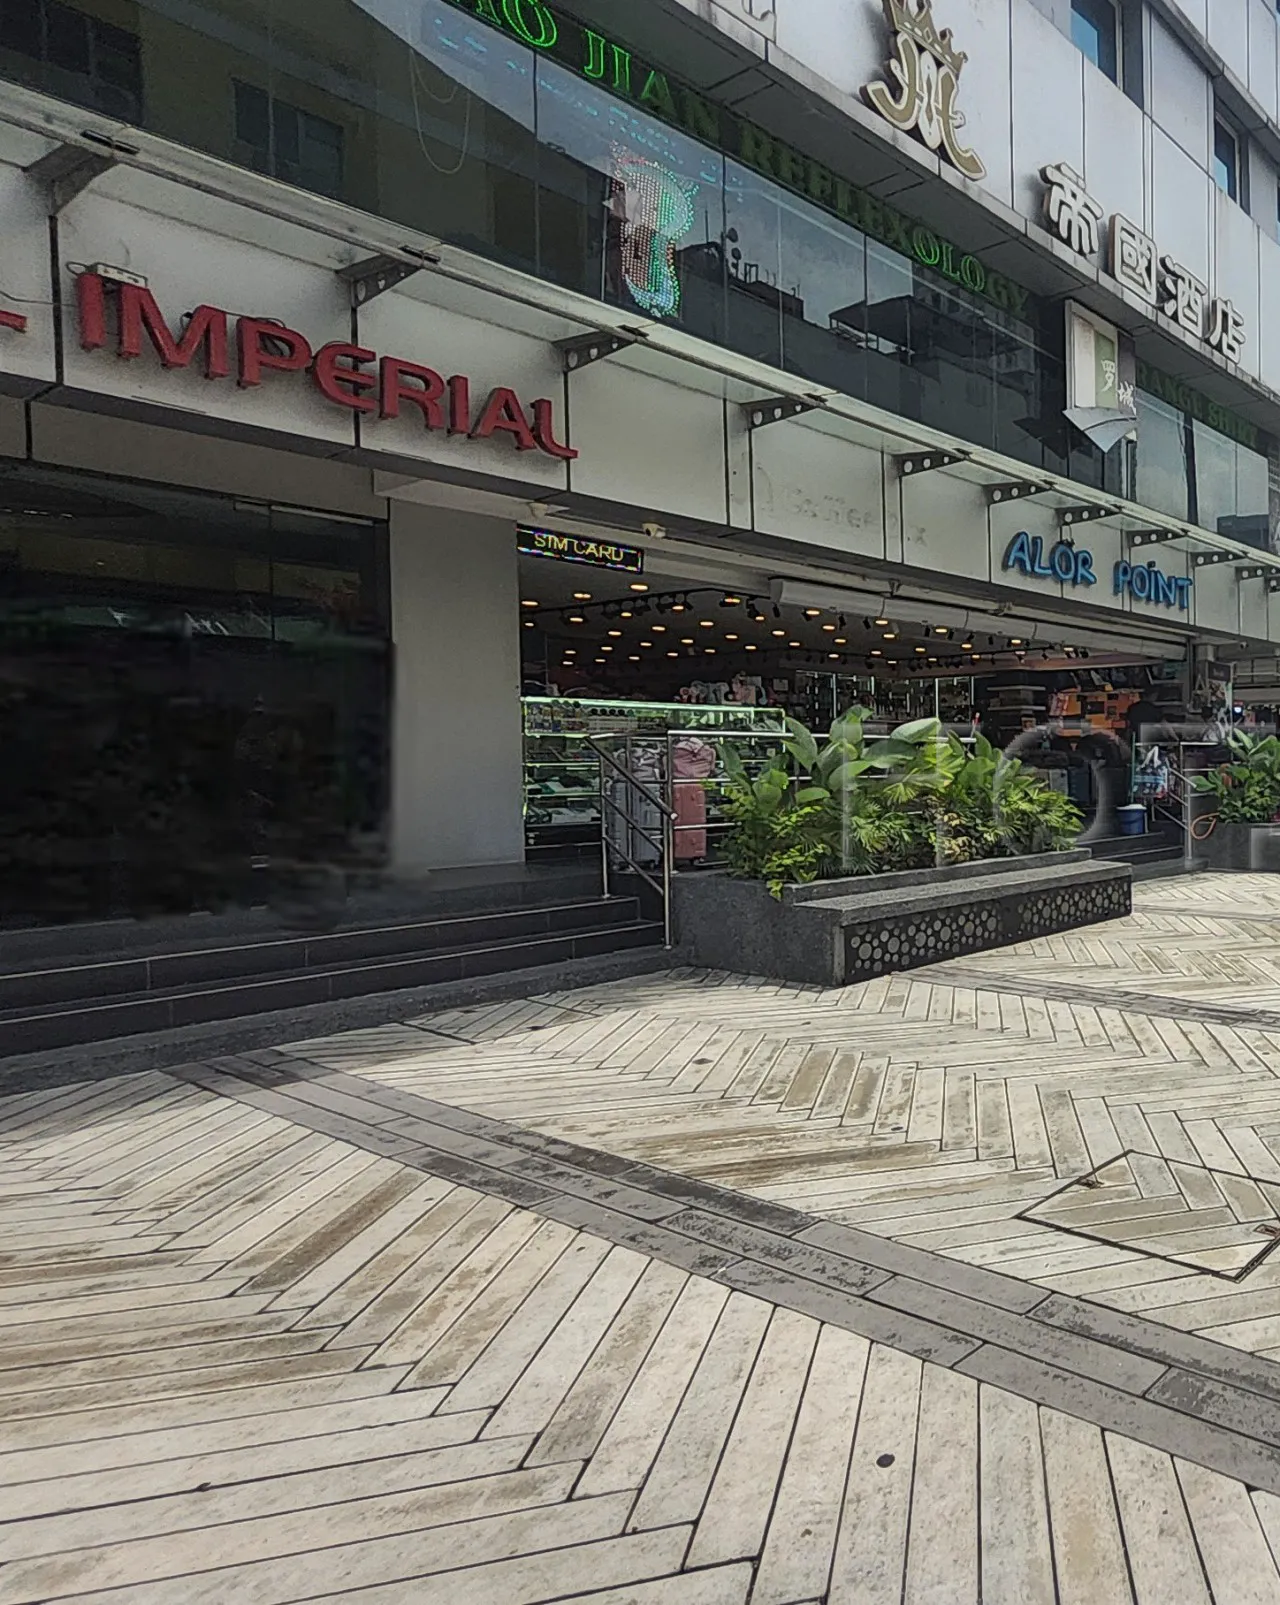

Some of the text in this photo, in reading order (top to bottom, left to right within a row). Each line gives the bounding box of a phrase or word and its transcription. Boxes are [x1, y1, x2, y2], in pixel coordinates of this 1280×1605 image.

[1040, 161, 1247, 365] 帝國酒店
[76, 273, 578, 459] IMPERIAL
[534, 533, 568, 552] SIM
[1003, 531, 1097, 585] ALOR
